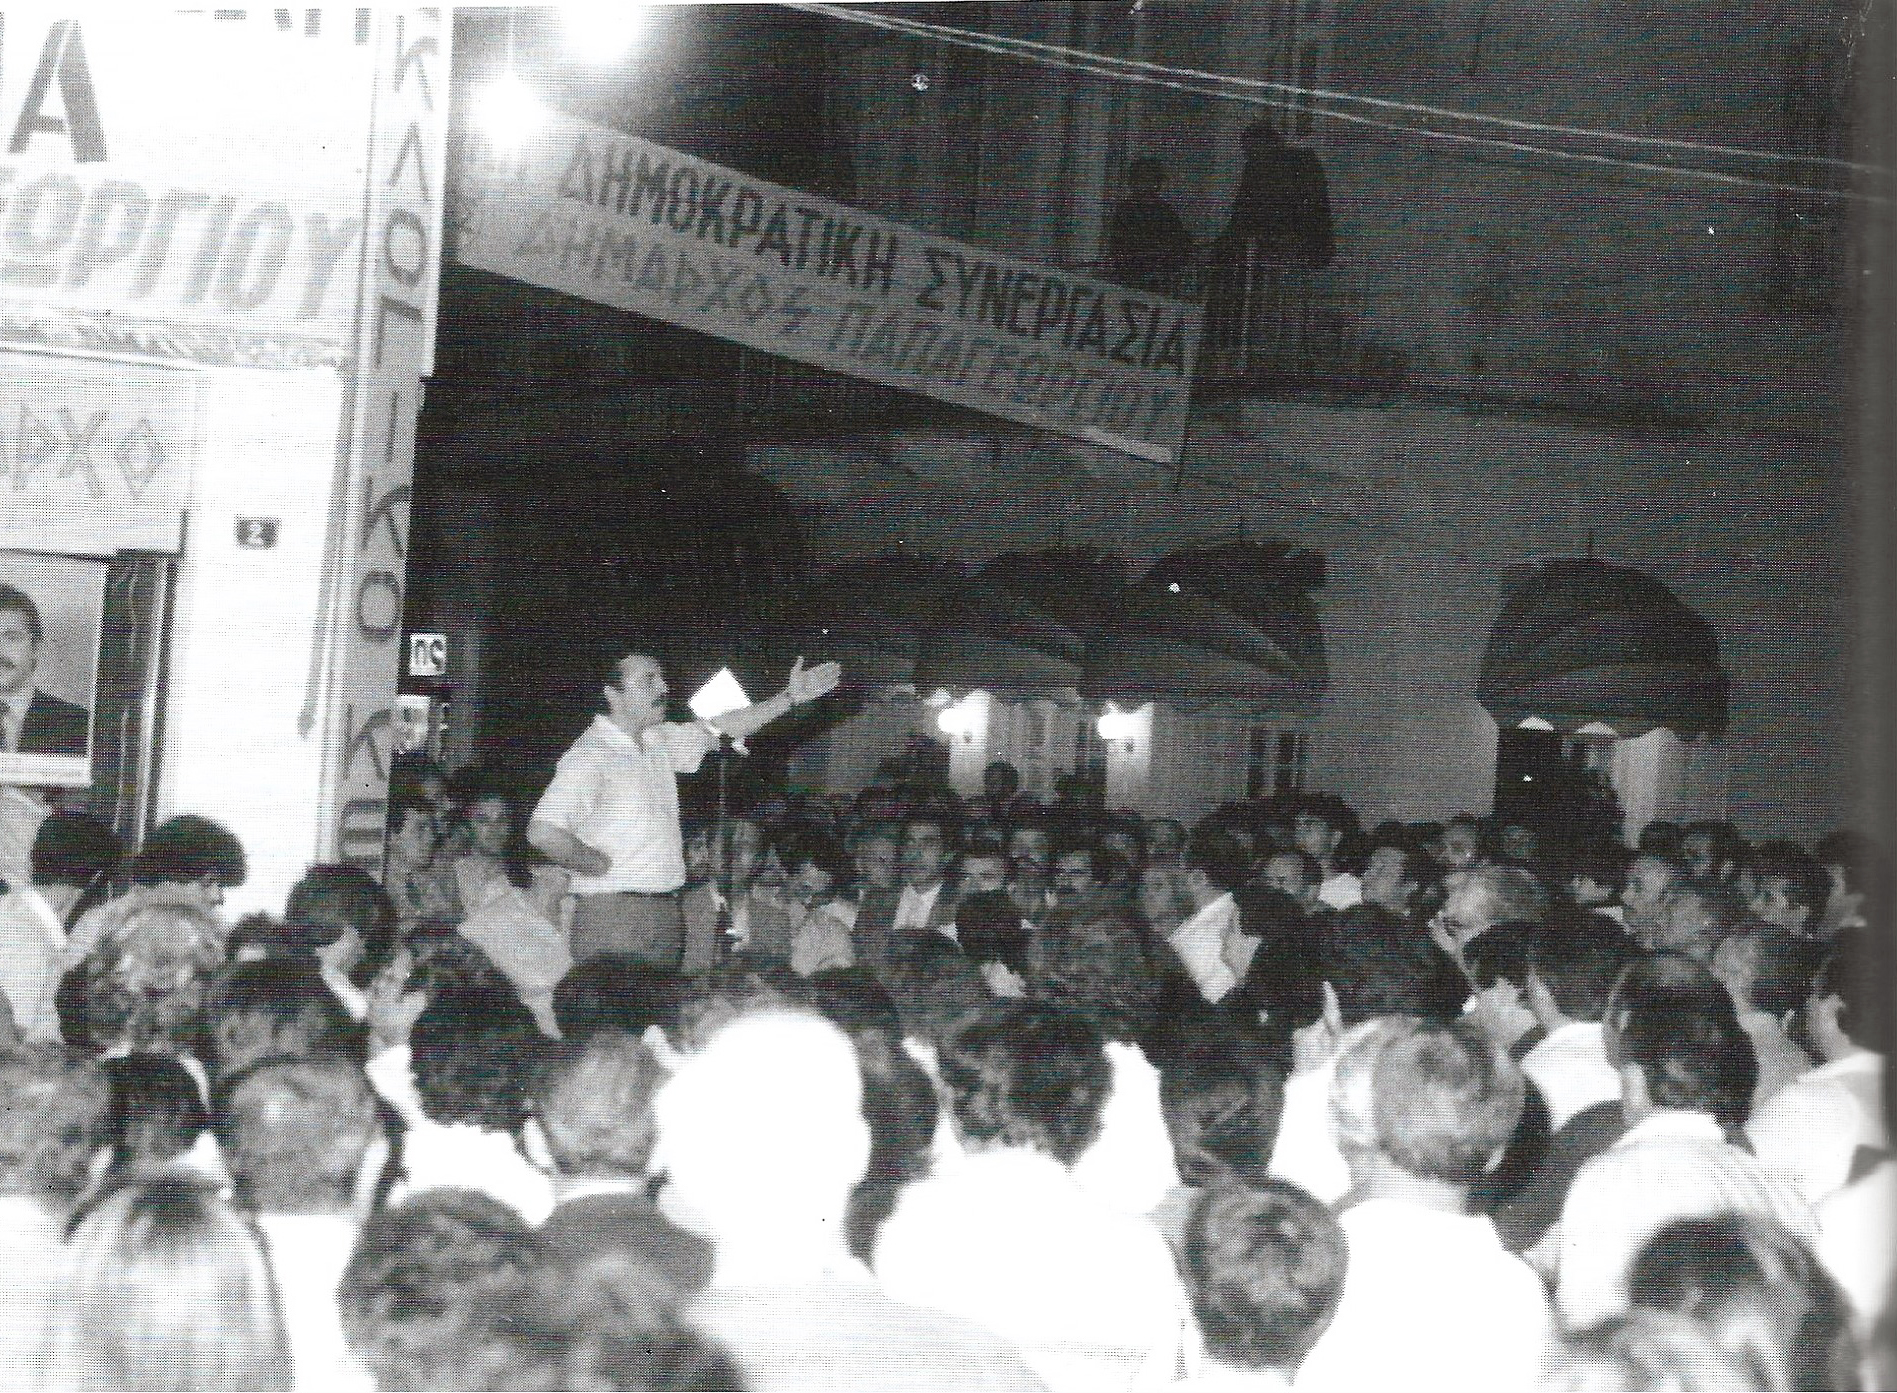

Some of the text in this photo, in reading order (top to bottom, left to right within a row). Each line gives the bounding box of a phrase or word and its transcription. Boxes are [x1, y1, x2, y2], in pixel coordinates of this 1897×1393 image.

[357, 9, 440, 640] ΚΛΟΓΙΚΟ
[558, 133, 1186, 380] ΔΗΜΟΚΡΑΤΙΚΗ ΣΥΝΕΡΓΑΣΙΑ
